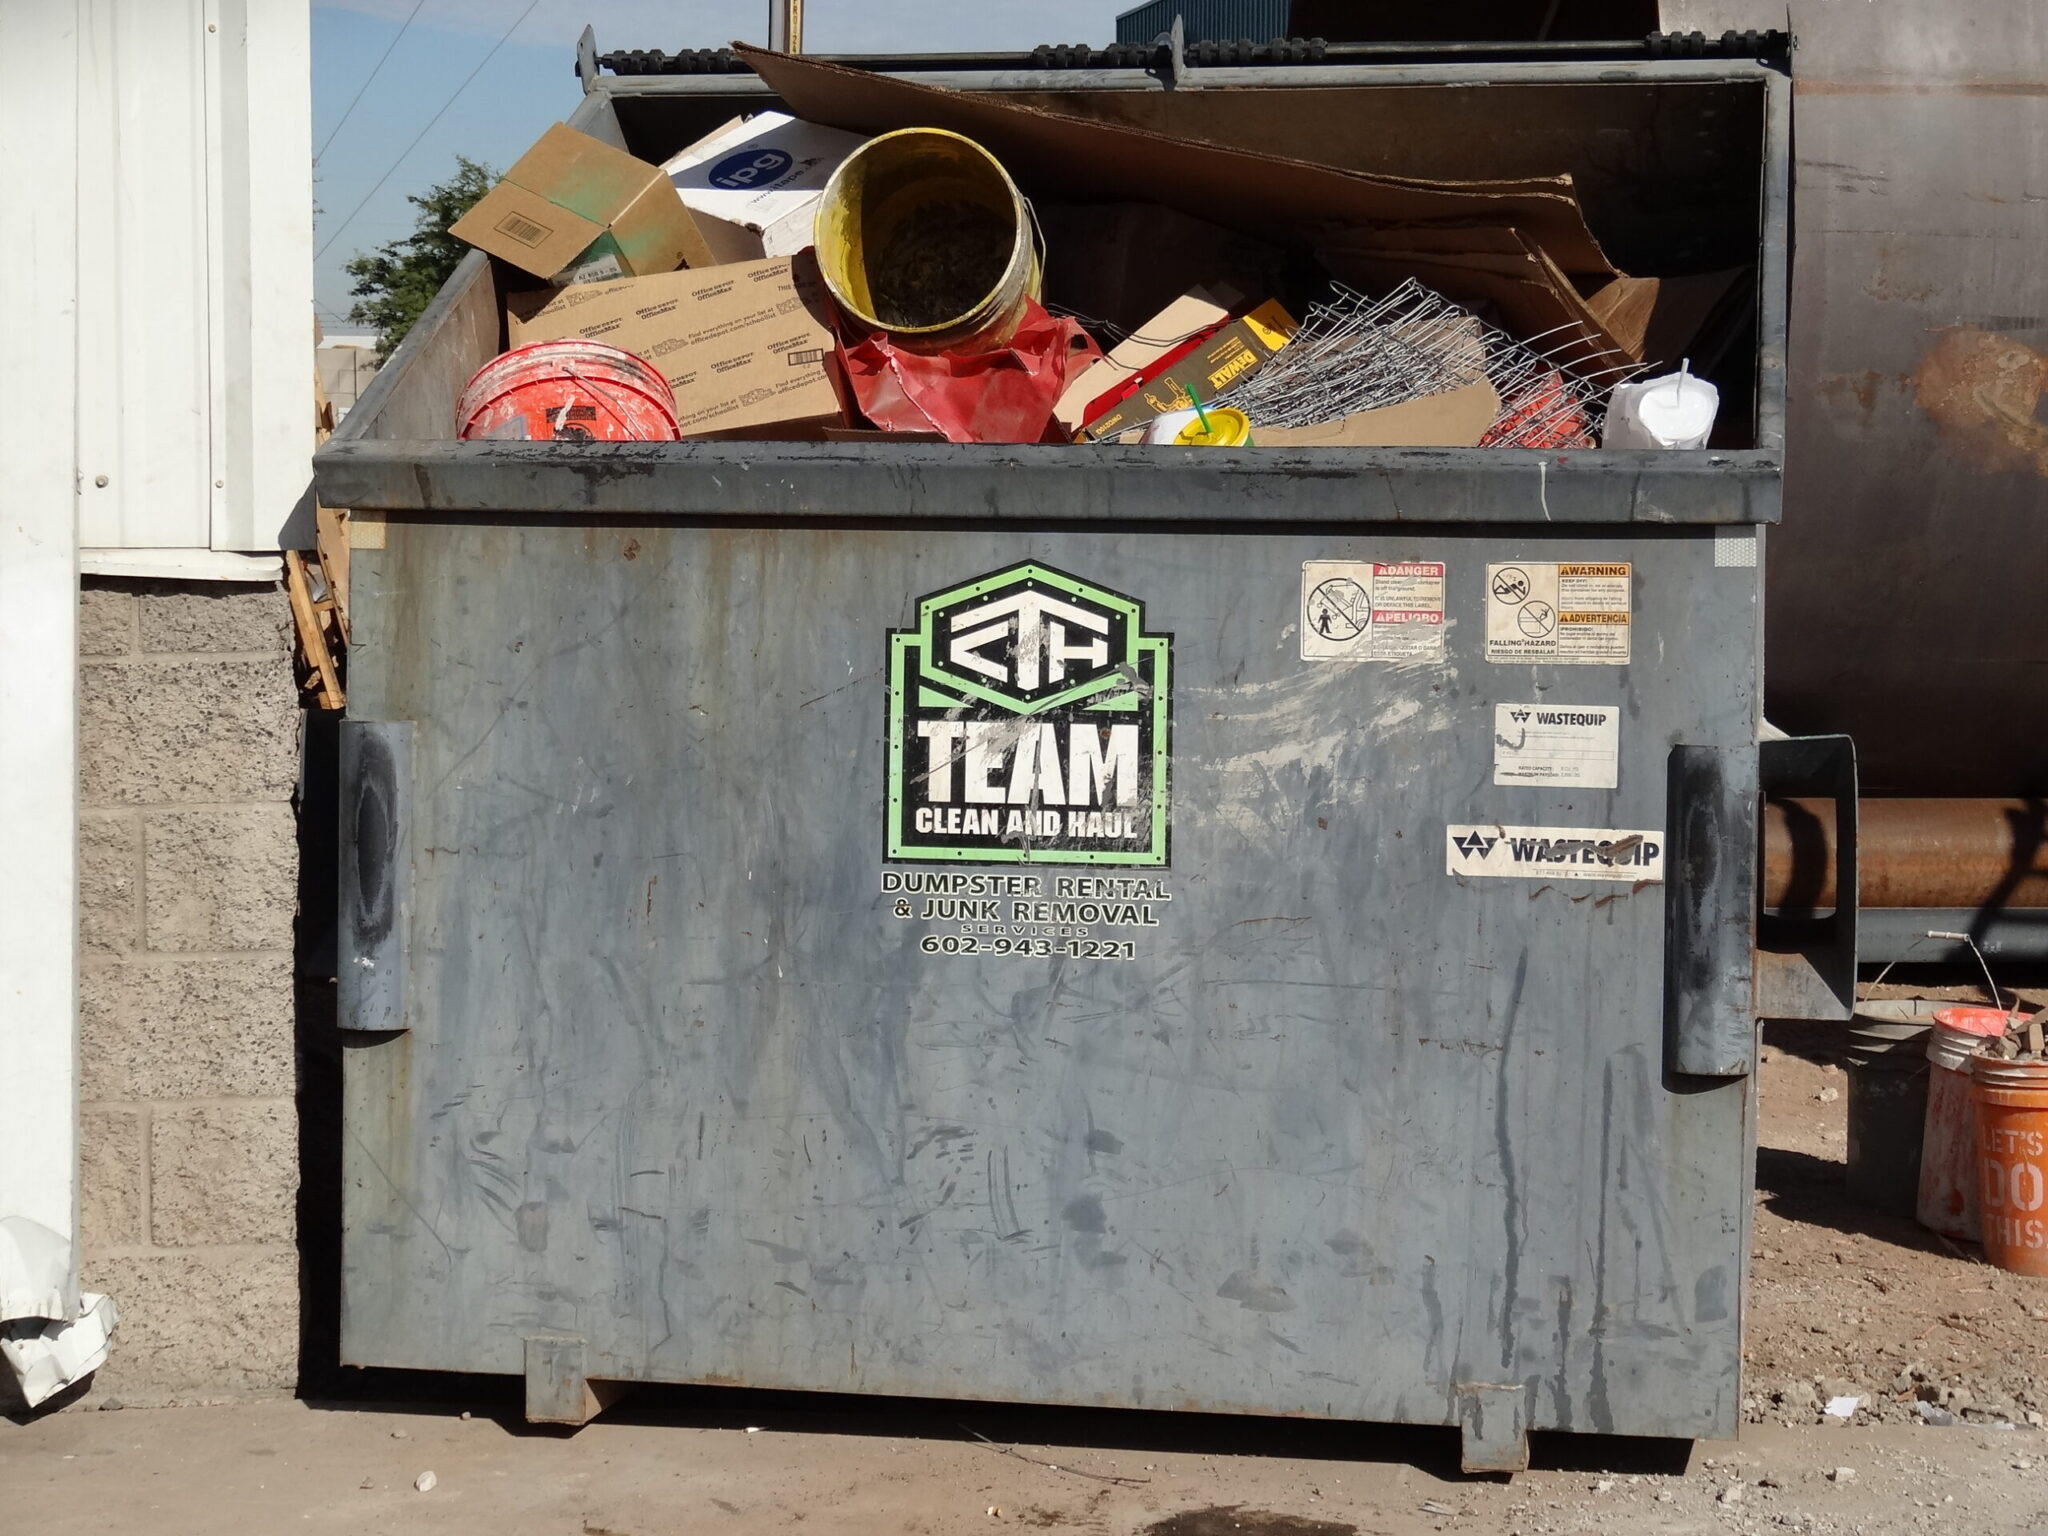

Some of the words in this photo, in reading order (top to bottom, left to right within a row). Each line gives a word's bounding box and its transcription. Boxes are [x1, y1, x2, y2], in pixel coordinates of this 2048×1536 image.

[716, 153, 785, 187] ipg
[748, 268, 769, 278] Office
[753, 268, 788, 283] OfficeMax
[692, 286, 713, 297] Office
[697, 286, 733, 301] OfficeMax
[636, 306, 657, 316] Office
[641, 304, 677, 320] OfficeMax
[579, 323, 600, 334] Office
[585, 324, 621, 338] OfficeMax
[767, 340, 788, 350] Office
[772, 339, 808, 354] OfficeMax
[710, 361, 730, 370] Office
[716, 359, 753, 374] OfficeMax
[1207, 349, 1258, 390] DEWALT
[1388, 566, 1438, 576] DANGER
[1569, 566, 1626, 576] WARNING
[1385, 613, 1439, 623] PELIGRO
[1570, 614, 1627, 623] ADVERTENCIA
[1537, 712, 1606, 726] WASTEQUIP
[917, 720, 1138, 807] TEAM
[915, 808, 998, 835] CLEAN
[1004, 810, 1061, 837] AND
[1068, 811, 1138, 838] HAUL
[882, 872, 1042, 897] DUMPSTER
[1056, 878, 1171, 900] RENTAL
[894, 899, 912, 919] &
[922, 900, 999, 921] JUNK
[1012, 902, 1159, 926] REMOVAL
[962, 924, 1088, 936] SERVICES
[921, 936, 1135, 960] 602-943-1221
[1983, 1125, 2043, 1156] LET'S
[1984, 1157, 2043, 1212] DO
